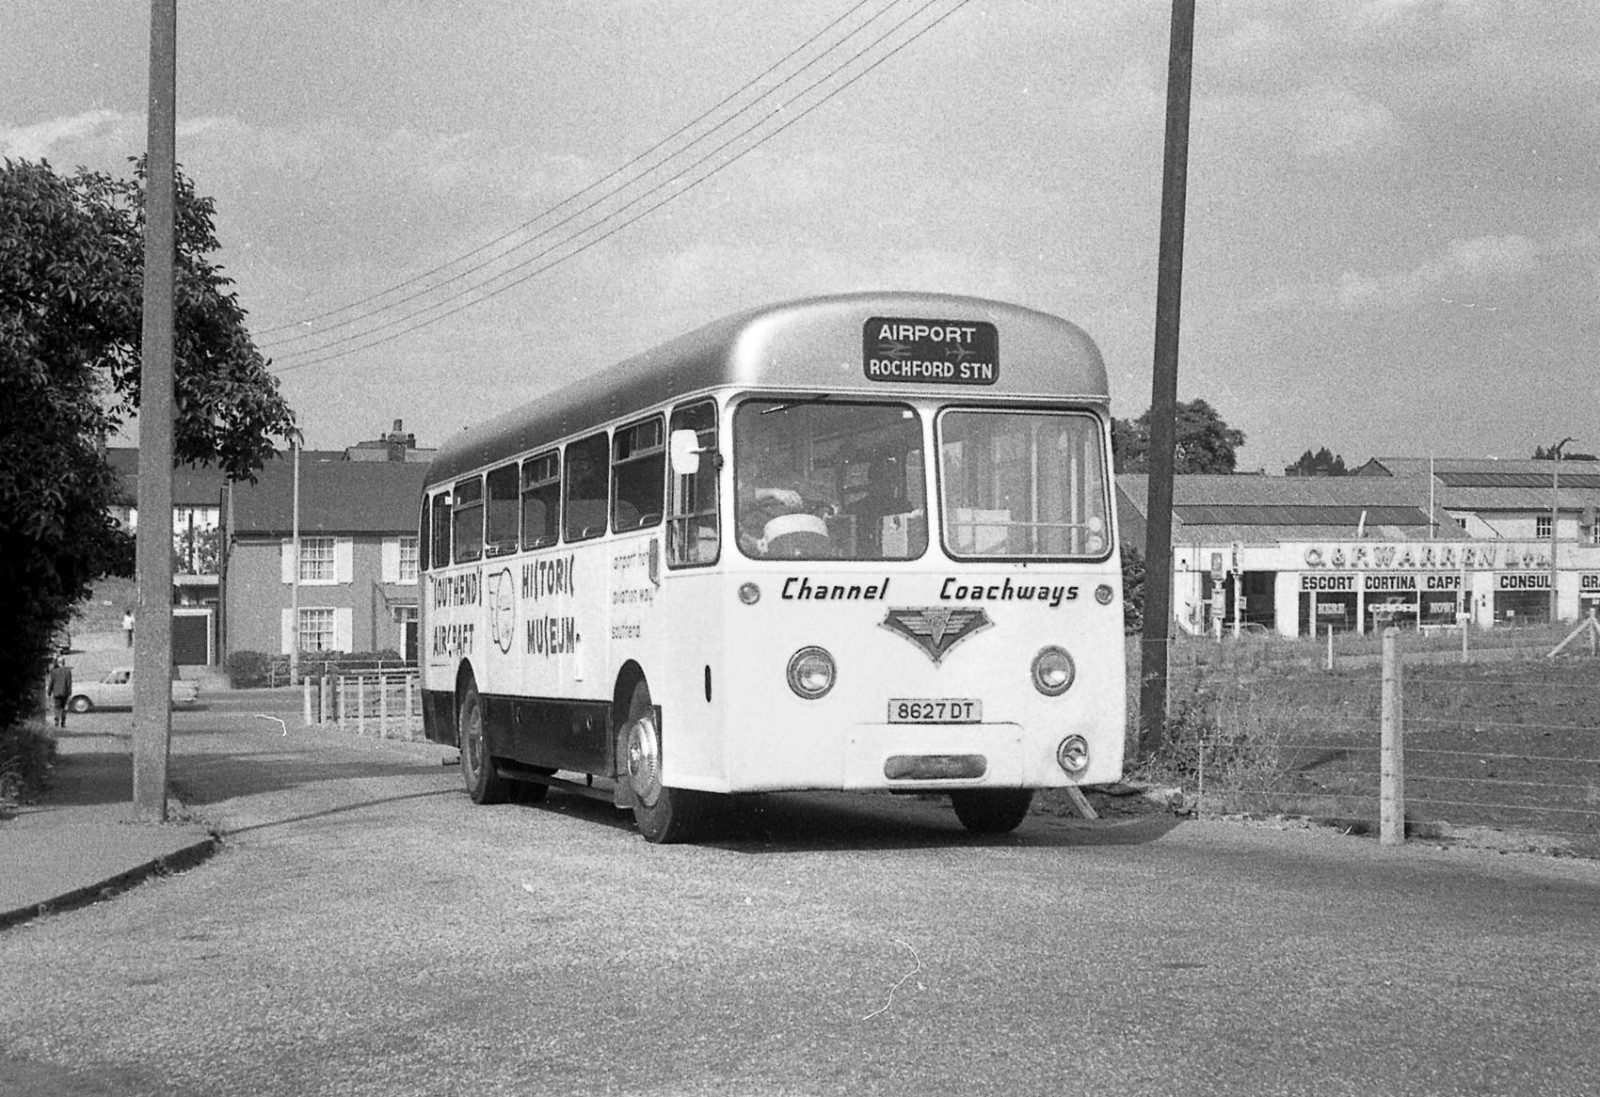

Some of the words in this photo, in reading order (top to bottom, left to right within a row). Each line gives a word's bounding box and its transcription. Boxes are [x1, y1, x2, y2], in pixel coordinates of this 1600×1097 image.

[878, 323, 977, 343] AIRPORT
[869, 359, 955, 377] ROCHFORD
[960, 361, 993, 379] STN
[1373, 546, 1495, 568] WARREN
[522, 553, 575, 602] HISTORIC
[1302, 576, 1354, 590] ESCORT
[1365, 576, 1416, 589] CORTINA
[1500, 575, 1551, 588] CONSUL
[781, 577, 890, 600] Channel
[939, 577, 1079, 607] Coachways
[433, 623, 474, 658] AIRCRAFT
[898, 702, 945, 719] 8627
[950, 702, 974, 719] DT
